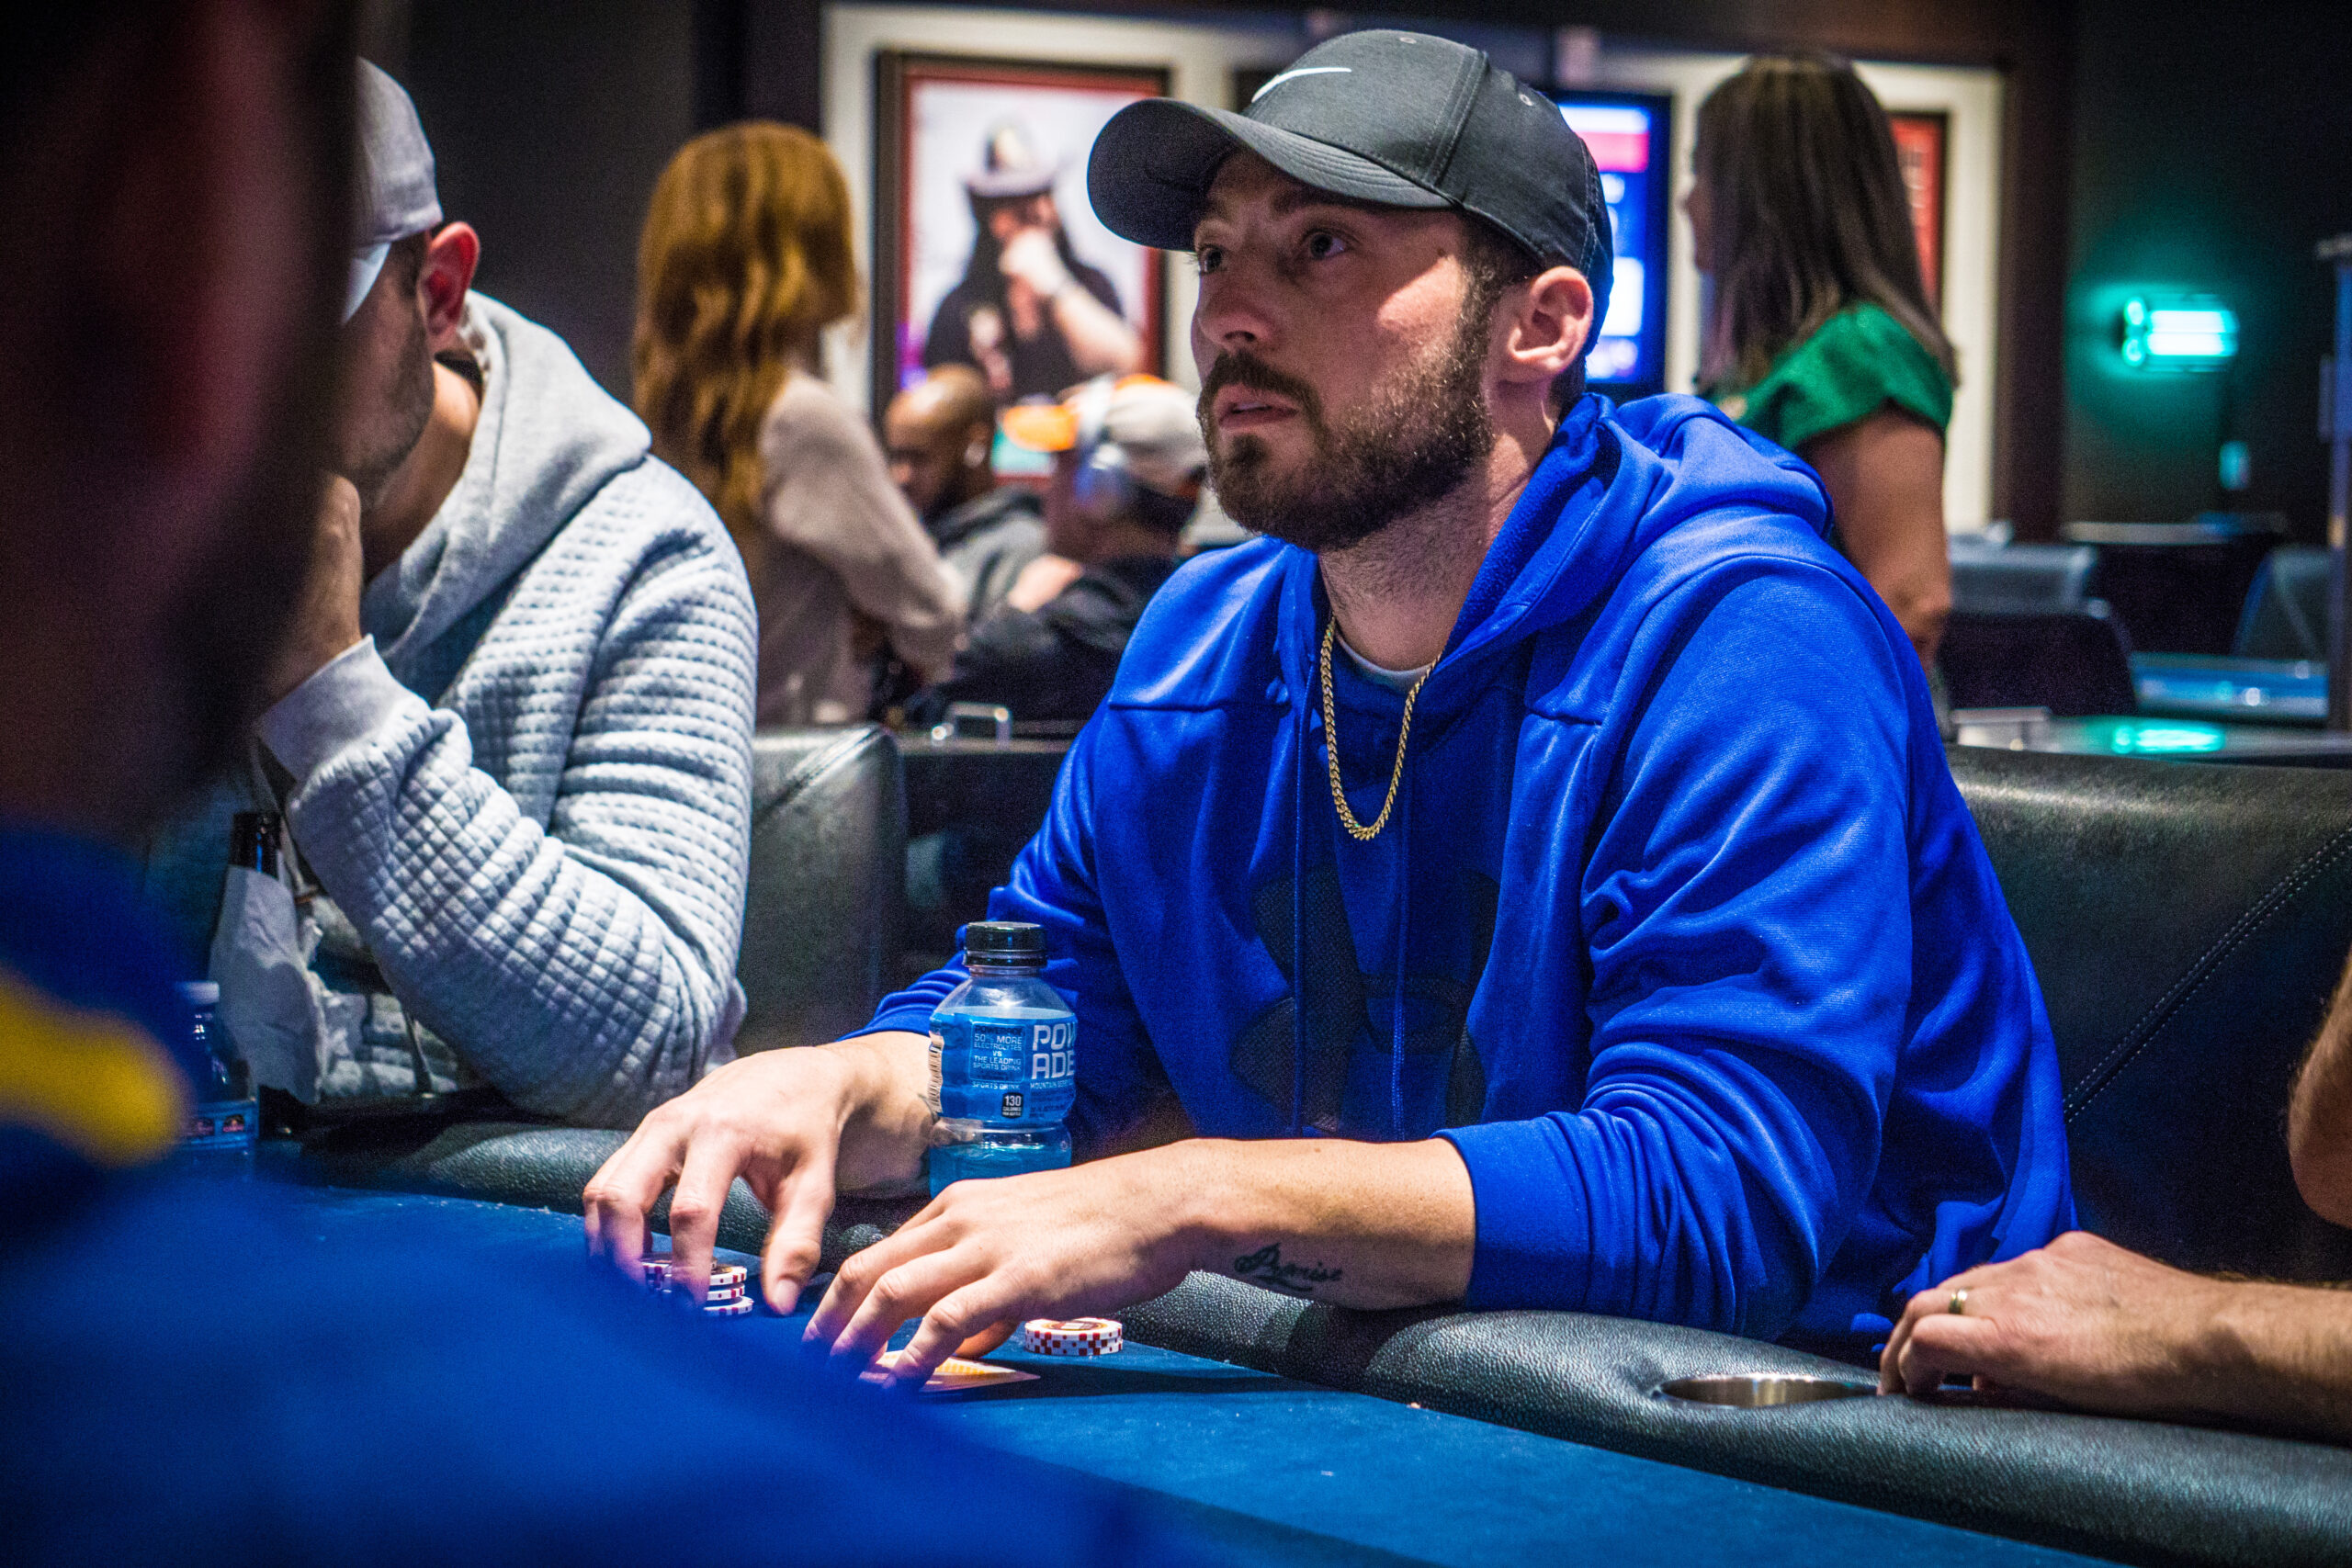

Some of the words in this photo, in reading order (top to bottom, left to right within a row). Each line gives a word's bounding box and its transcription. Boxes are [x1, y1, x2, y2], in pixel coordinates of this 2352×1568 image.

[997, 1035, 1023, 1044] MORE
[973, 1062, 999, 1070] SPORTS
[972, 1080, 999, 1089] SPORTS
[1004, 1095, 1022, 1107] 130
